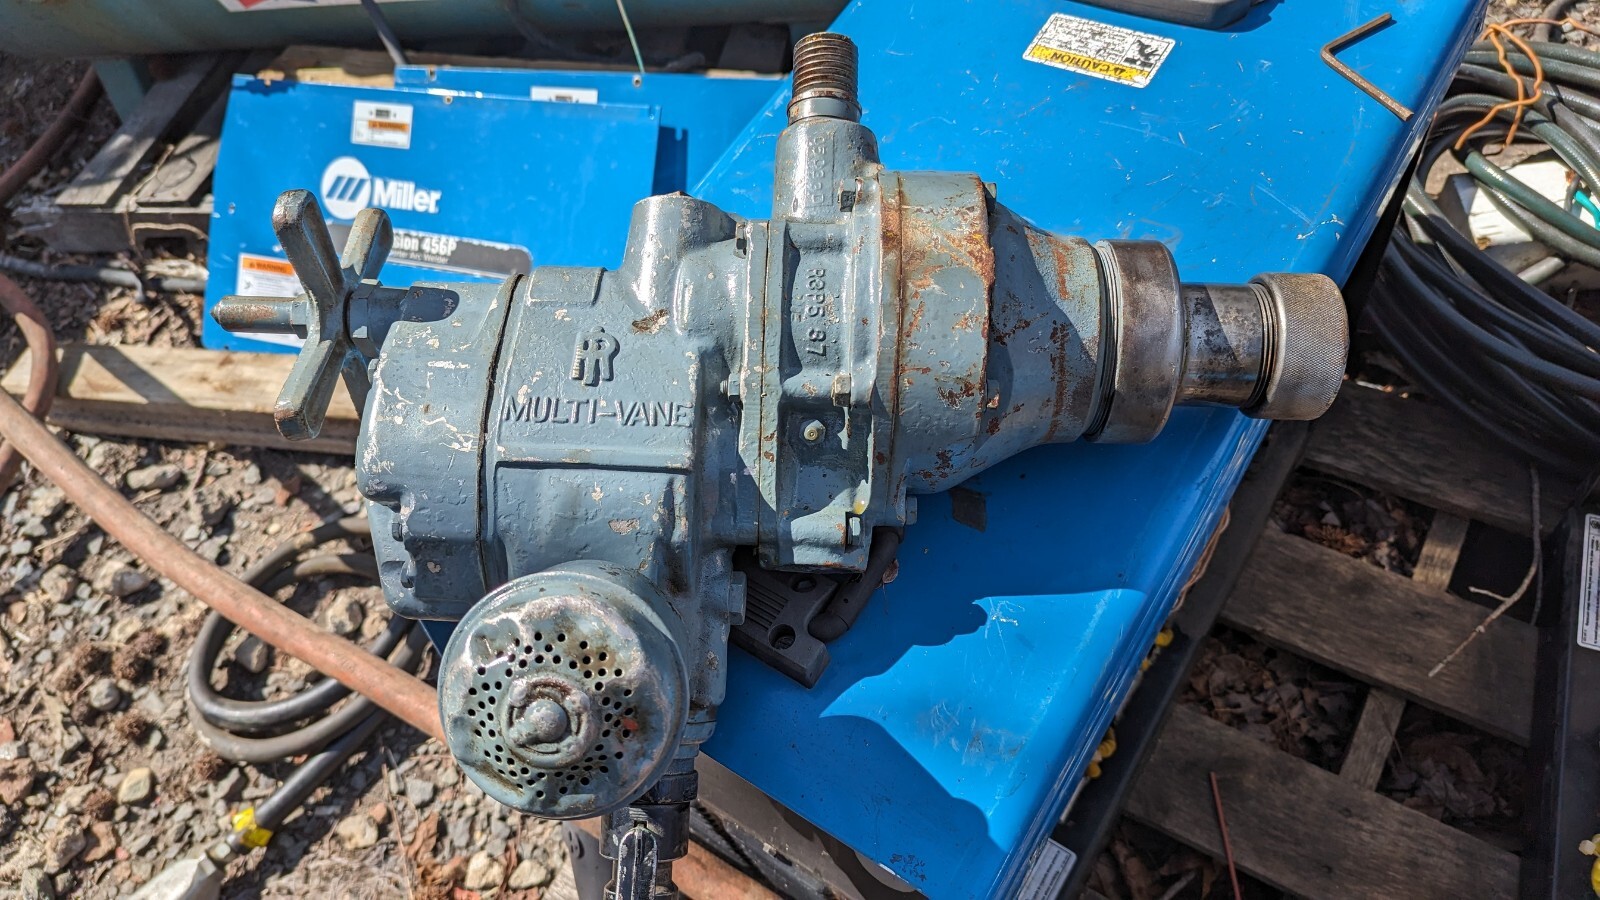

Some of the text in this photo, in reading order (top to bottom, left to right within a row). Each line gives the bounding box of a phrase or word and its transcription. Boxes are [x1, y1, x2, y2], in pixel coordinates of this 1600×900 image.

[1051, 52, 1113, 73] CAUTION
[373, 177, 442, 213] Miller
[392, 232, 457, 257] sion 456P
[502, 396, 696, 428] MULTI-VANE
